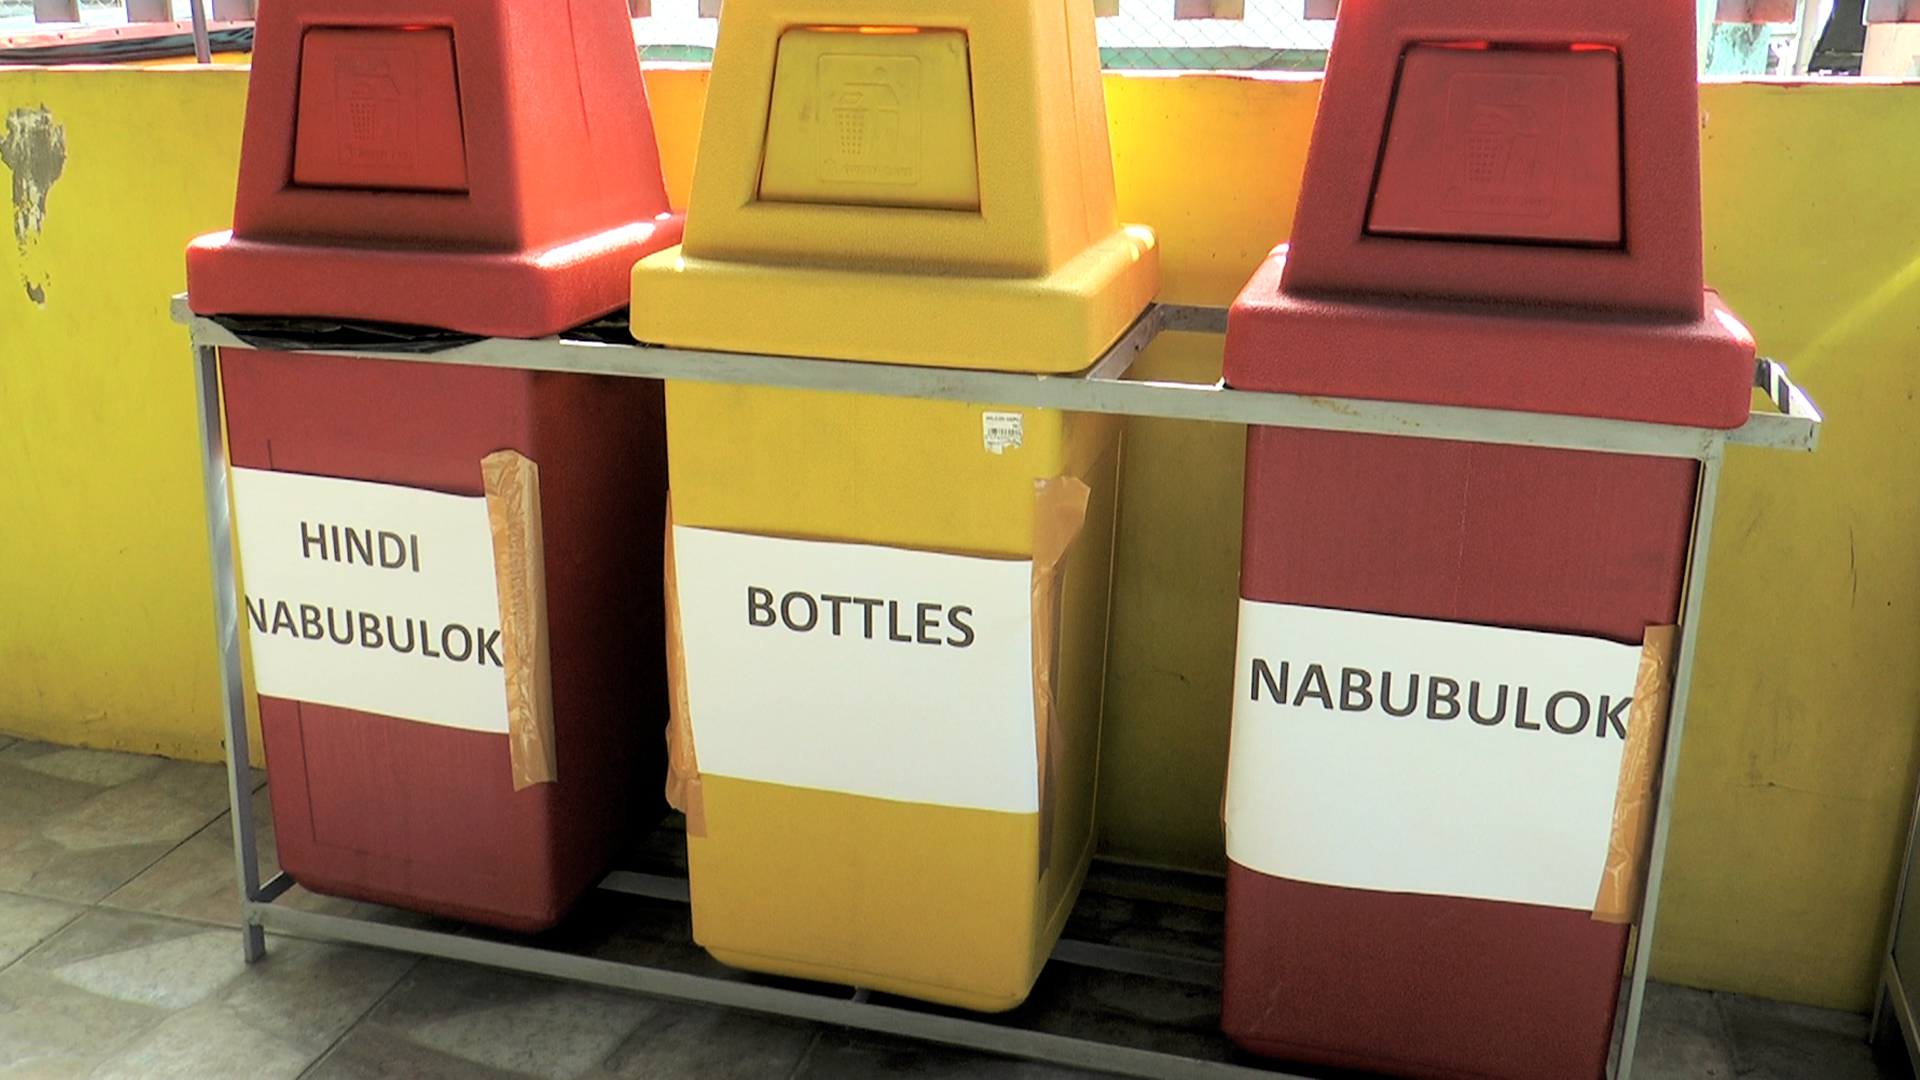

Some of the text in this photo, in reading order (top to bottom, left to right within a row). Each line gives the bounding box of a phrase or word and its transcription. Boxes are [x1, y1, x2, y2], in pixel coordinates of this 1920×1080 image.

[300, 521, 420, 572] HINDI
[245, 594, 503, 668] NABUBULOK
[748, 586, 975, 648] BOTTLES
[1250, 658, 1632, 740] NABUBULOK
